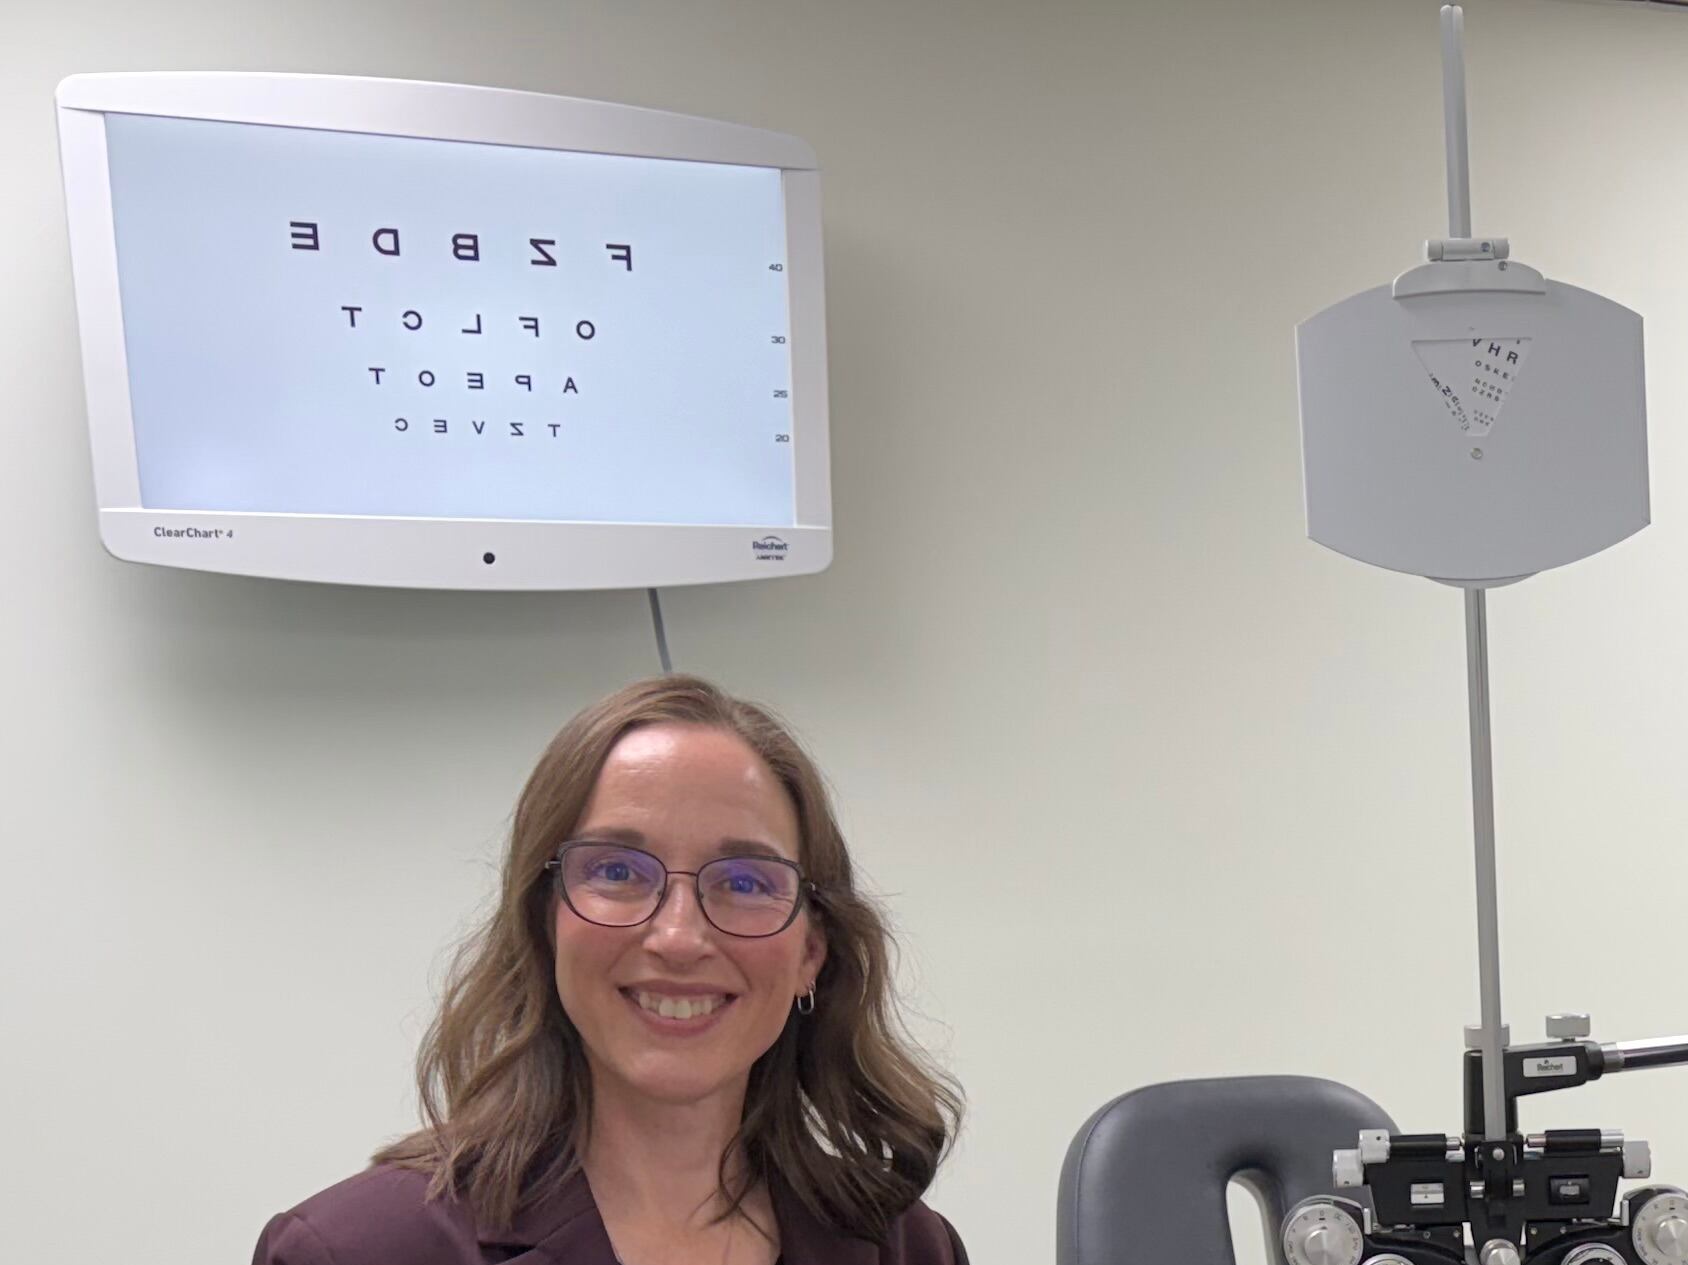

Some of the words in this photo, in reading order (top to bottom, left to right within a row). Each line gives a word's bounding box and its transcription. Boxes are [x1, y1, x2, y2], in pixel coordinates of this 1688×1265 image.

[769, 264, 783, 272] 40
[771, 336, 785, 344] 30
[773, 390, 788, 398] 25
[776, 434, 789, 442] 20
[226, 529, 233, 538] 4
